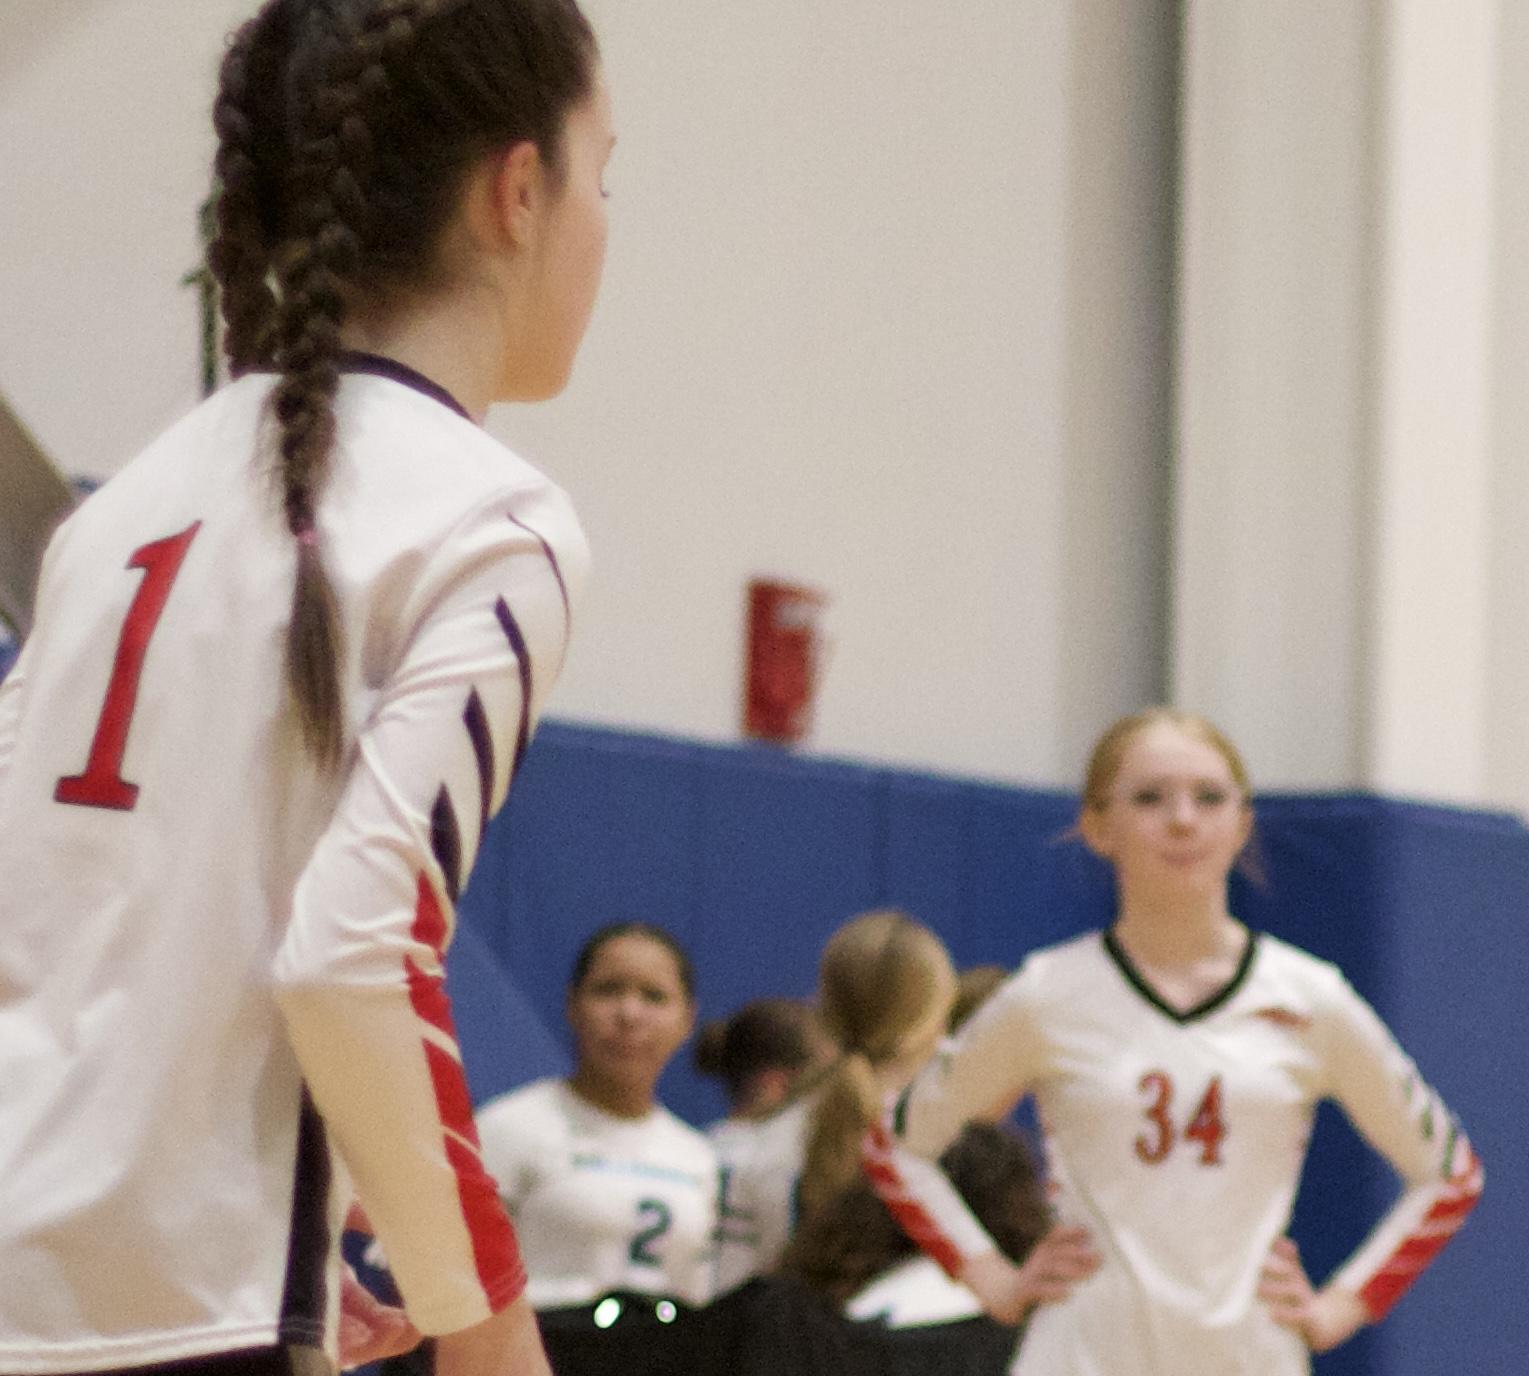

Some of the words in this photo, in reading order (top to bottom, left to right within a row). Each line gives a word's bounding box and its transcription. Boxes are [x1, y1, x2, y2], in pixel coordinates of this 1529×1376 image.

[54, 519, 202, 811] 1
[1135, 1072, 1227, 1167] 34
[629, 1196, 672, 1267] 2
